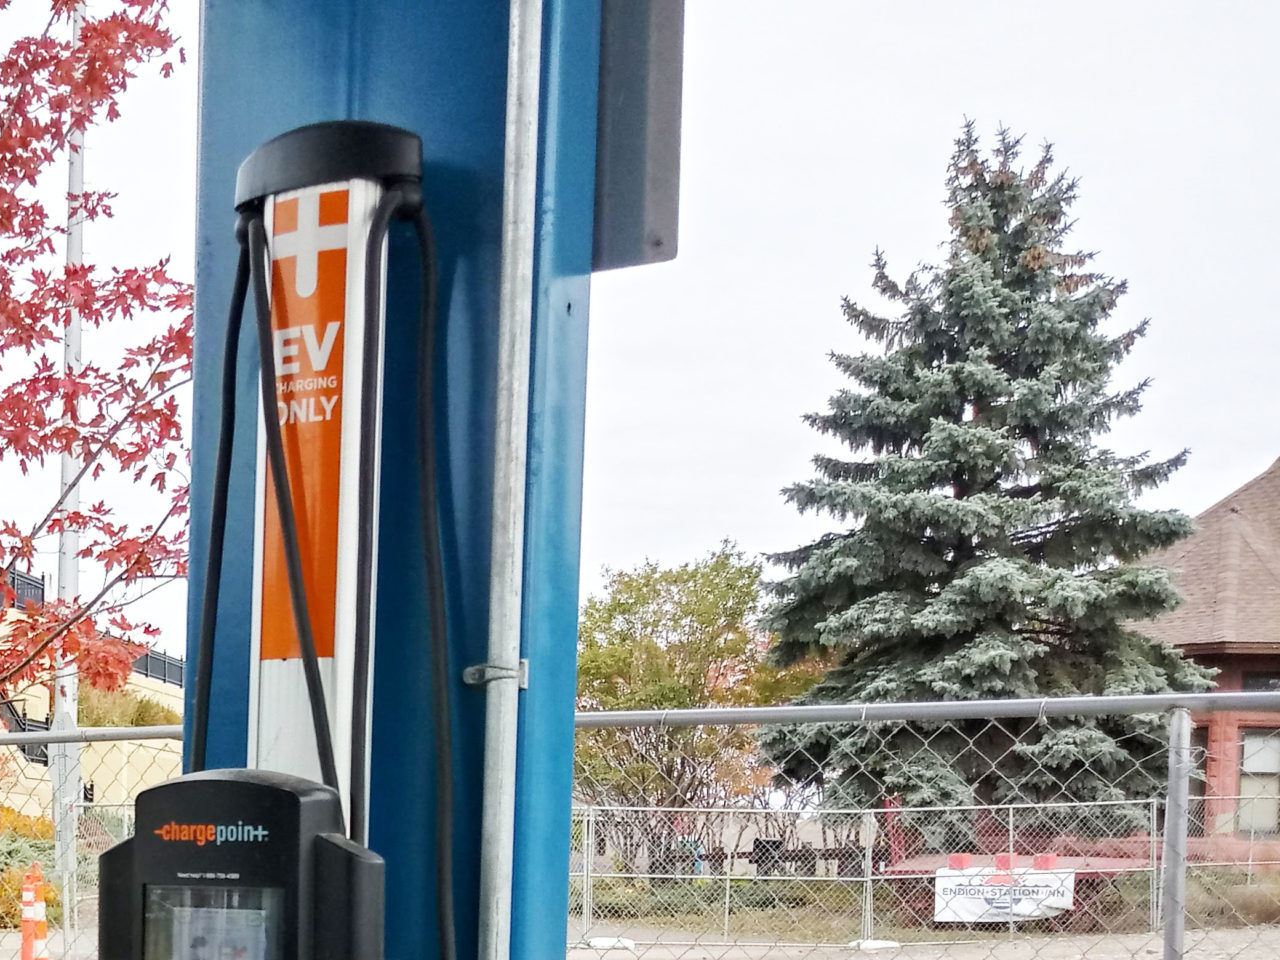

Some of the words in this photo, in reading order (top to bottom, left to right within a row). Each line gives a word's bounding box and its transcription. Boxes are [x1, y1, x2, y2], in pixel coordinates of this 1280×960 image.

[274, 321, 340, 377] EV
[154, 820, 269, 846] chargepoint
[942, 887, 985, 897] ENDION
[990, 888, 1040, 897] STATION
